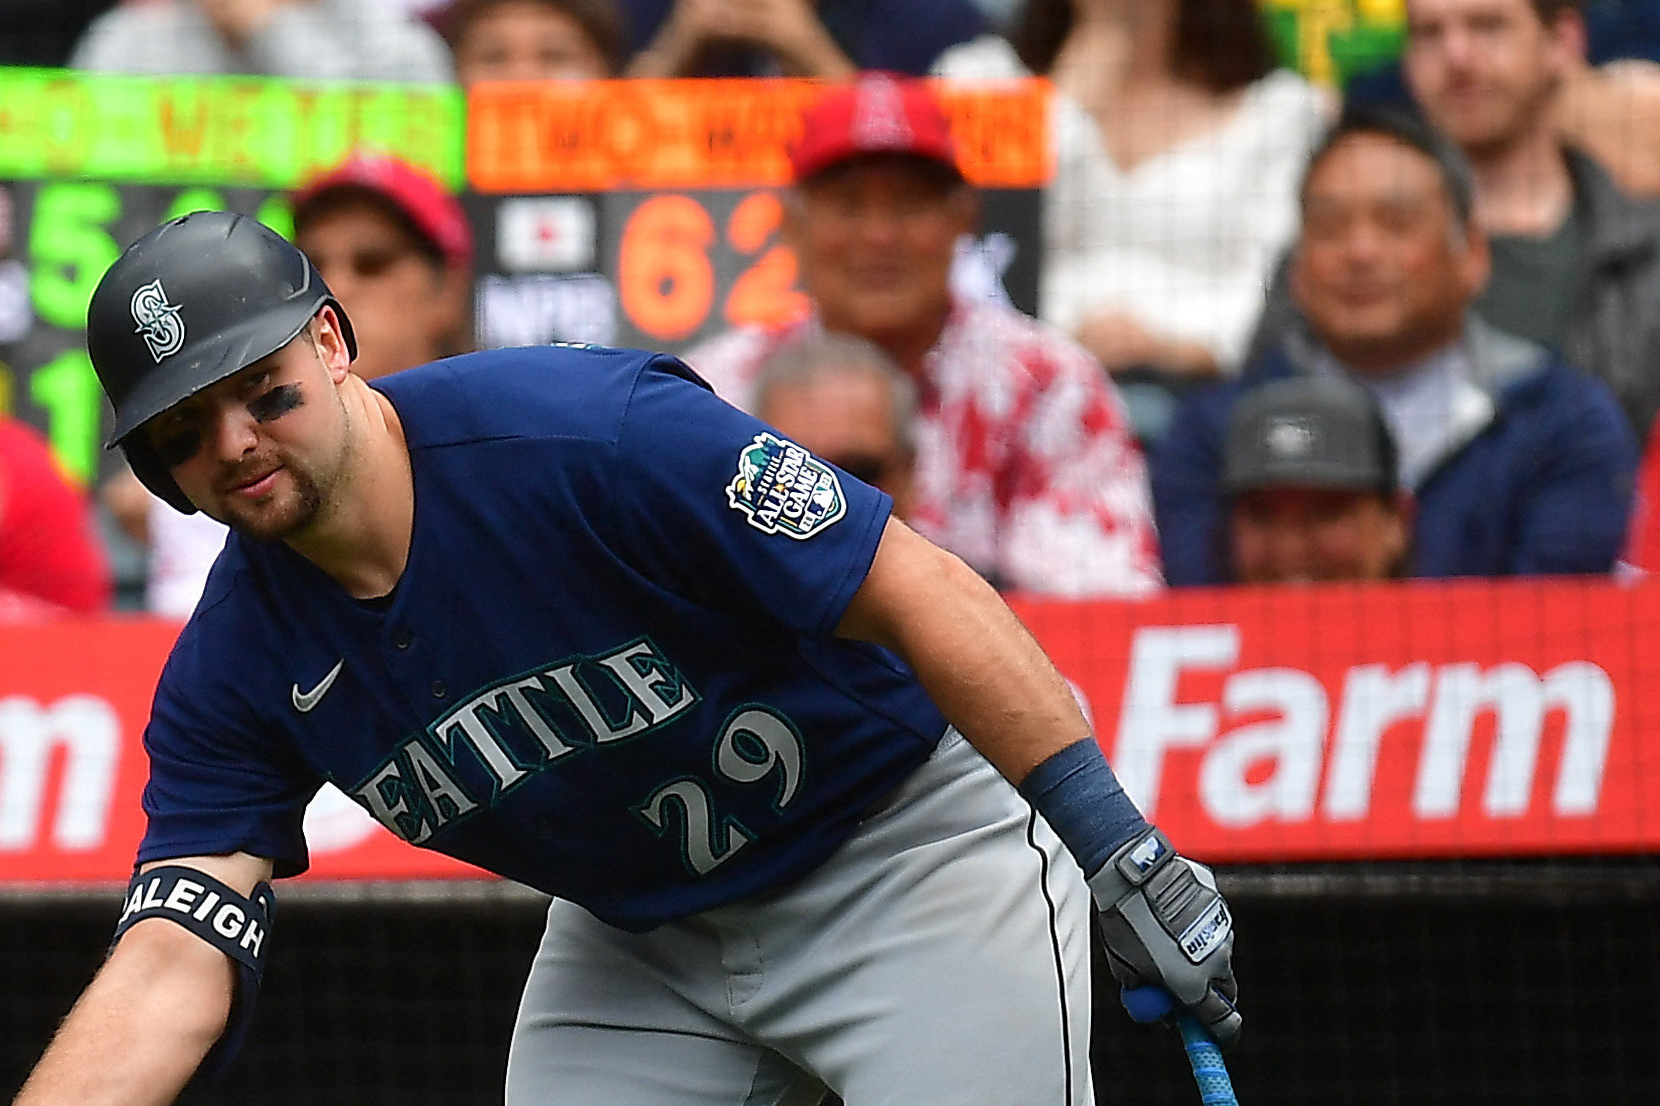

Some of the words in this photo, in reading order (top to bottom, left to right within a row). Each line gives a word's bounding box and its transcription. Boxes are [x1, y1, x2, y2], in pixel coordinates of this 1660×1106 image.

[782, 465, 819, 519] GAME
[352, 638, 702, 846] EATTLE
[630, 702, 808, 876] 29
[1112, 622, 1616, 828] Farm
[118, 877, 265, 958] ALEIGH
